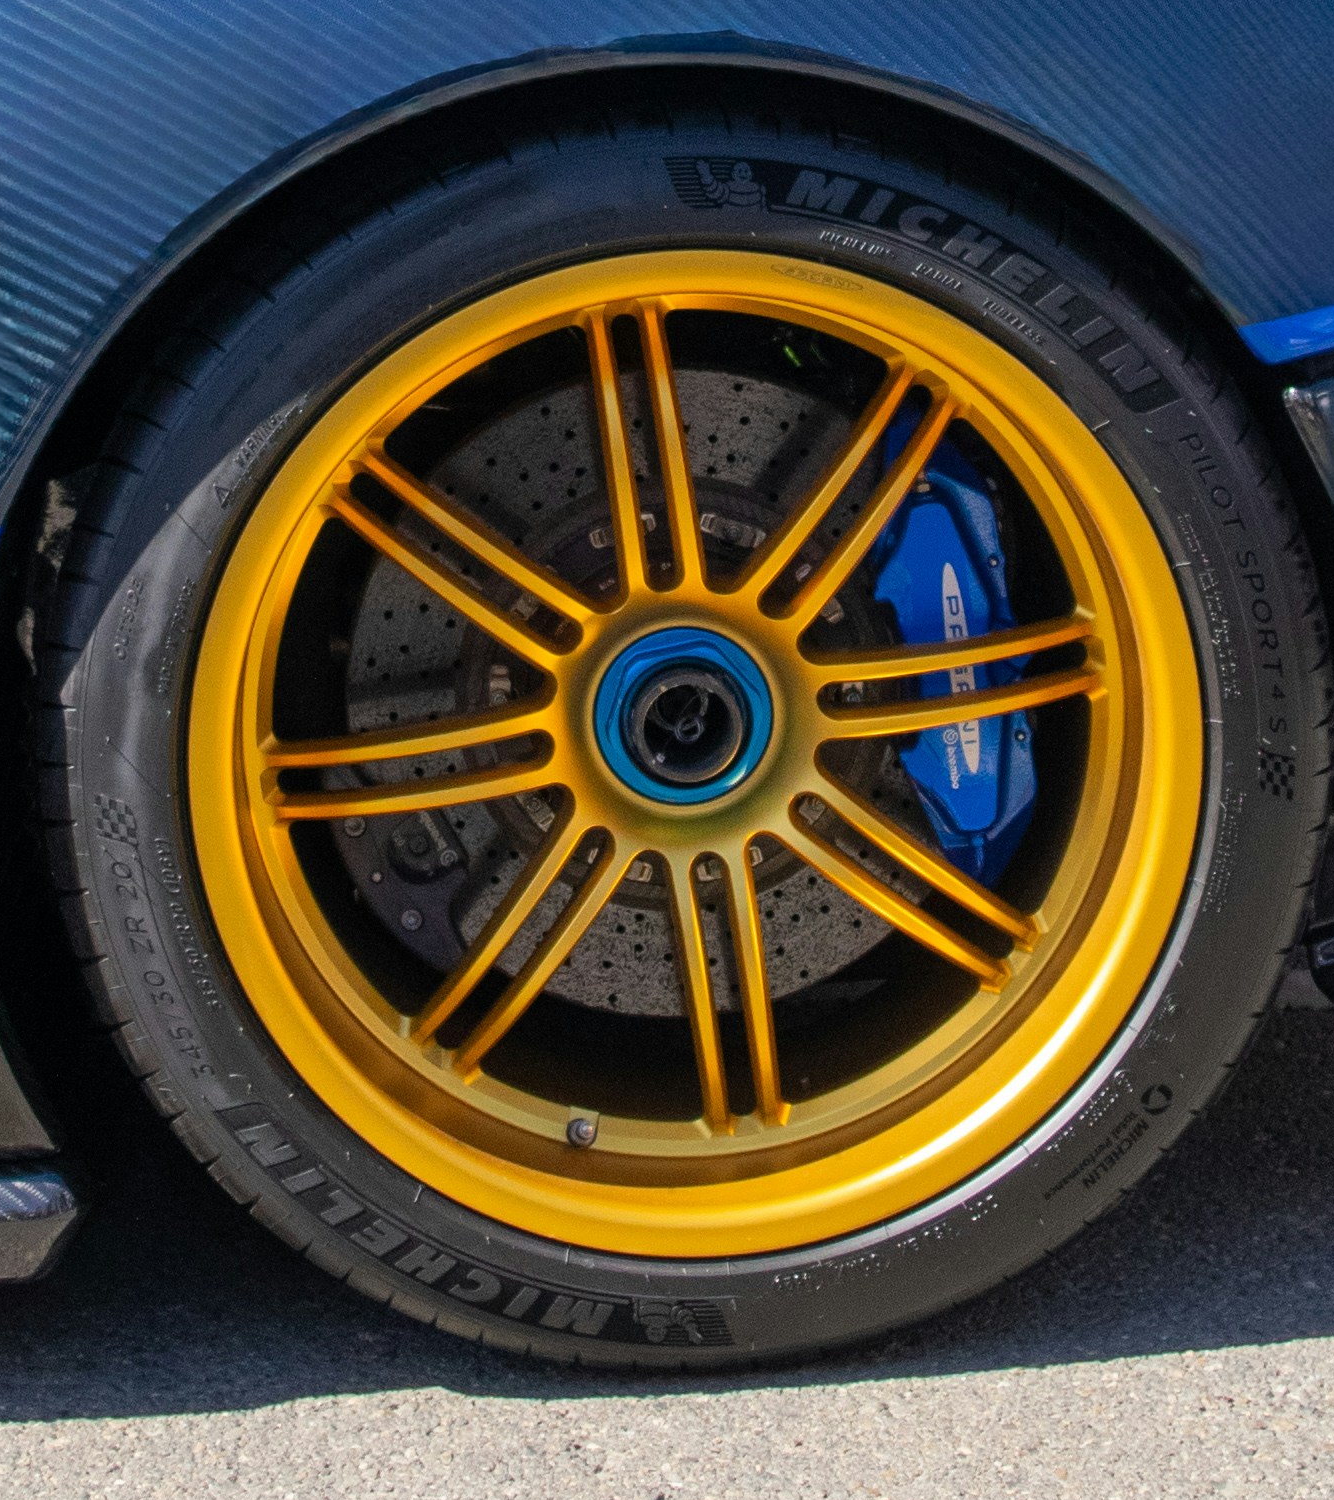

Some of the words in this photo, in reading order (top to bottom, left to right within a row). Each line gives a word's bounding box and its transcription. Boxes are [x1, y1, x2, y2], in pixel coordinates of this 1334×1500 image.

[785, 170, 1160, 396] MICHELIN
[1179, 432, 1245, 535] PILOT
[114, 576, 144, 660] OUTSIDE
[1236, 550, 1283, 679] SPORT
[1269, 682, 1286, 701] 4
[1269, 715, 1287, 733] S
[111, 860, 138, 900] 20
[125, 915, 154, 955] ZR
[145, 971, 215, 1079] 345/30
[1082, 1118, 1149, 1188] MICHELIN
[1113, 1111, 1138, 1137] Total
[1043, 1136, 1113, 1200] Performance
[236, 1122, 616, 1335] MICHELIN
